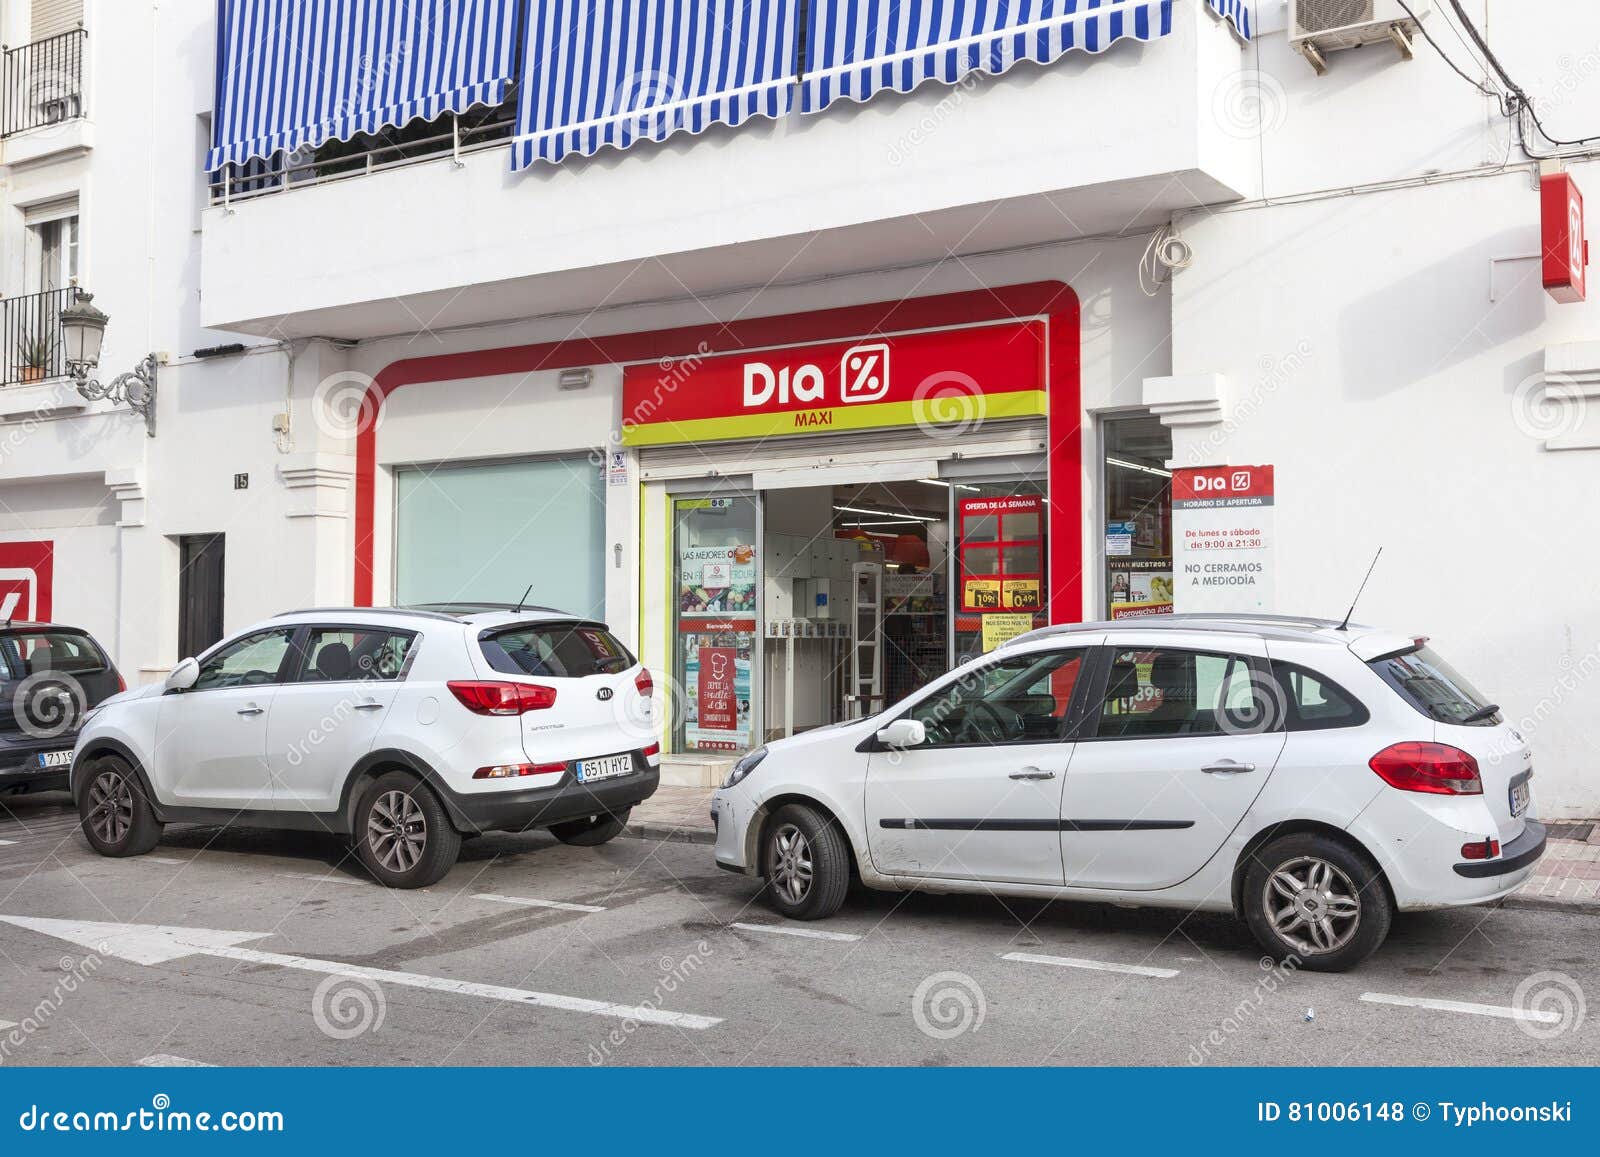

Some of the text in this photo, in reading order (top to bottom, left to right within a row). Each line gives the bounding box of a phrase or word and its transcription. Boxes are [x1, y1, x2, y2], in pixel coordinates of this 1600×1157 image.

[794, 410, 833, 427] MAXI
[235, 474, 248, 488] 15
[1183, 500, 1214, 508] HORARIO
[1185, 530, 1196, 538] De
[1199, 529, 1220, 537] lunes
[1190, 541, 1202, 549] de
[1204, 540, 1225, 549] 9:00
[1235, 539, 1261, 548] 21:30
[696, 550, 726, 559] MEJORES
[1185, 562, 1262, 573] NO CERRAMOS
[683, 572, 693, 580] EN
[1192, 573, 1256, 586] A MEDIODÍA
[599, 689, 612, 698] KIA
[585, 757, 629, 777] 6511 HYZ
